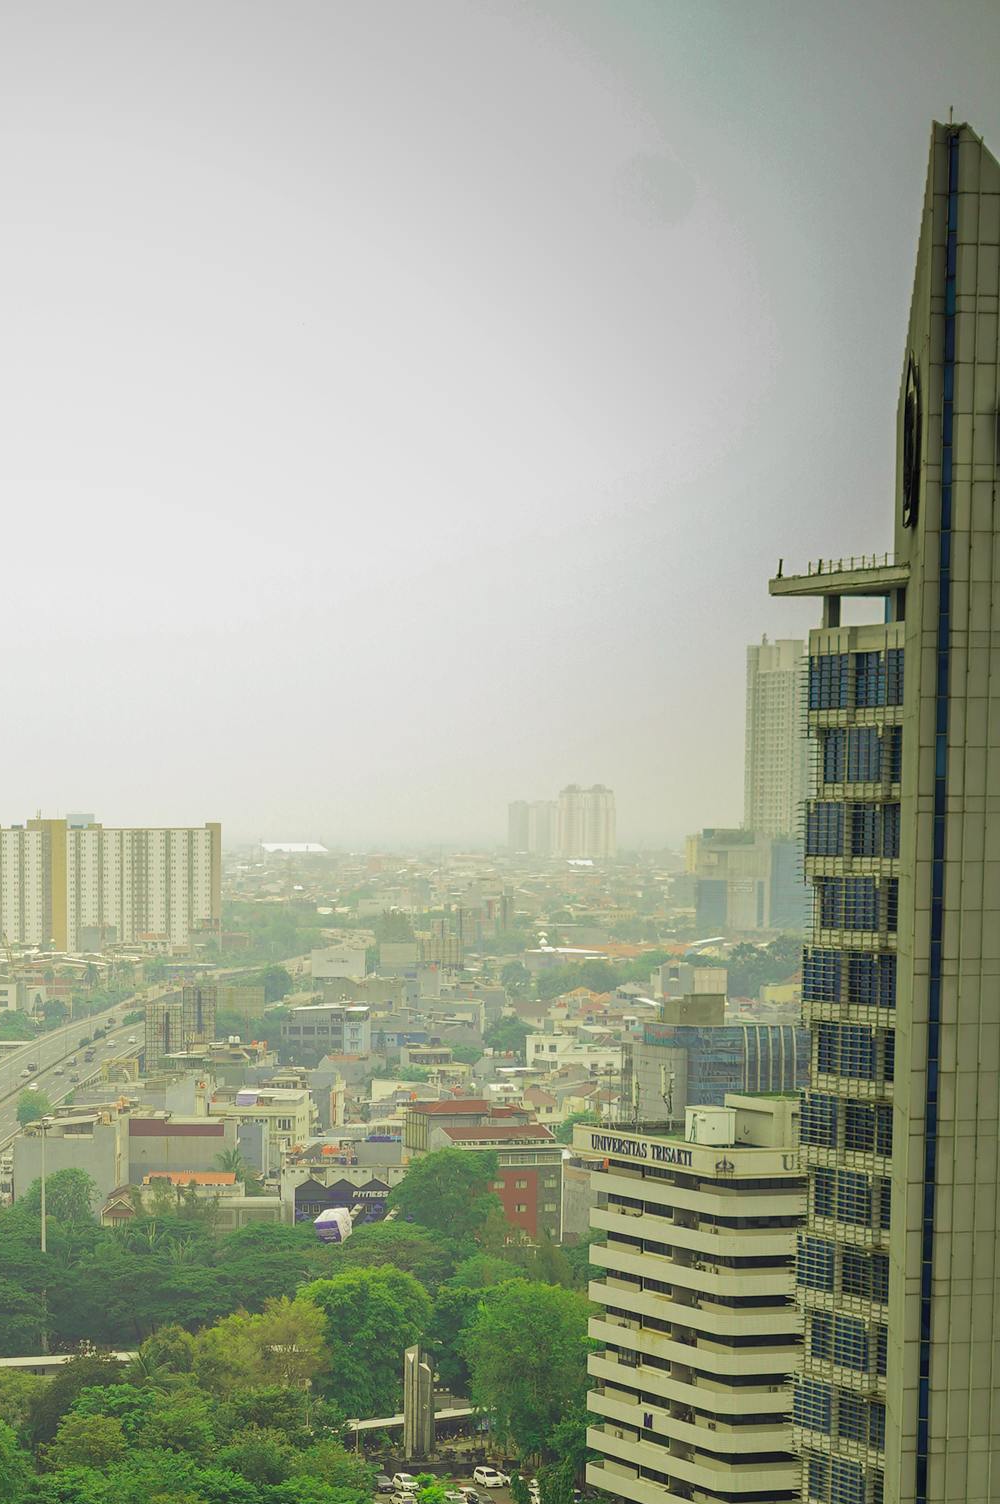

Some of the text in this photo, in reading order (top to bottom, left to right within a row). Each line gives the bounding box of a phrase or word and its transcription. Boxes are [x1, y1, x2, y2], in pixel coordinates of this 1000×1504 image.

[591, 1133, 693, 1168] UNIVERSITAS TRISAKTI
[352, 1190, 390, 1198] FITNESS
